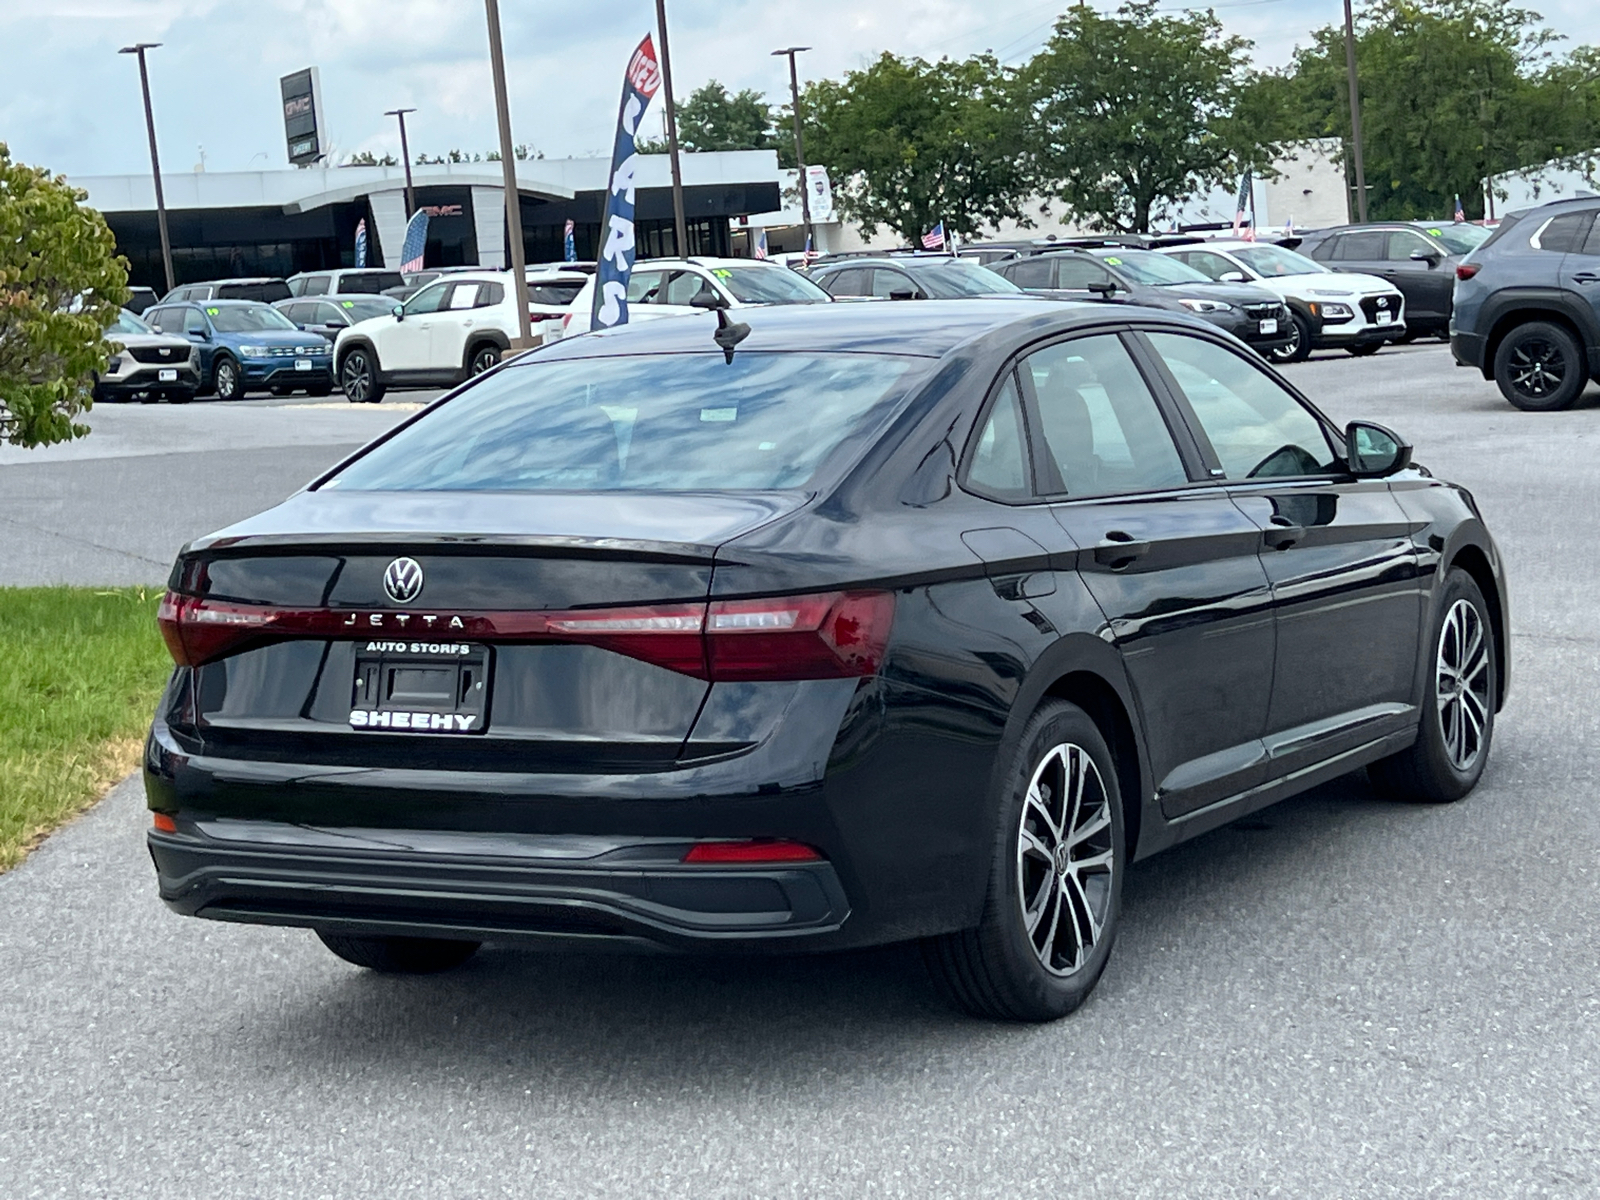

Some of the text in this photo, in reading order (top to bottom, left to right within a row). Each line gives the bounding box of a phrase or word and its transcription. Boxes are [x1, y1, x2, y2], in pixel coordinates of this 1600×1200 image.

[598, 92, 641, 327] CARS
[344, 613, 464, 628] JETTA
[366, 641, 407, 653] AUTO
[349, 710, 476, 730] SHEEHY
